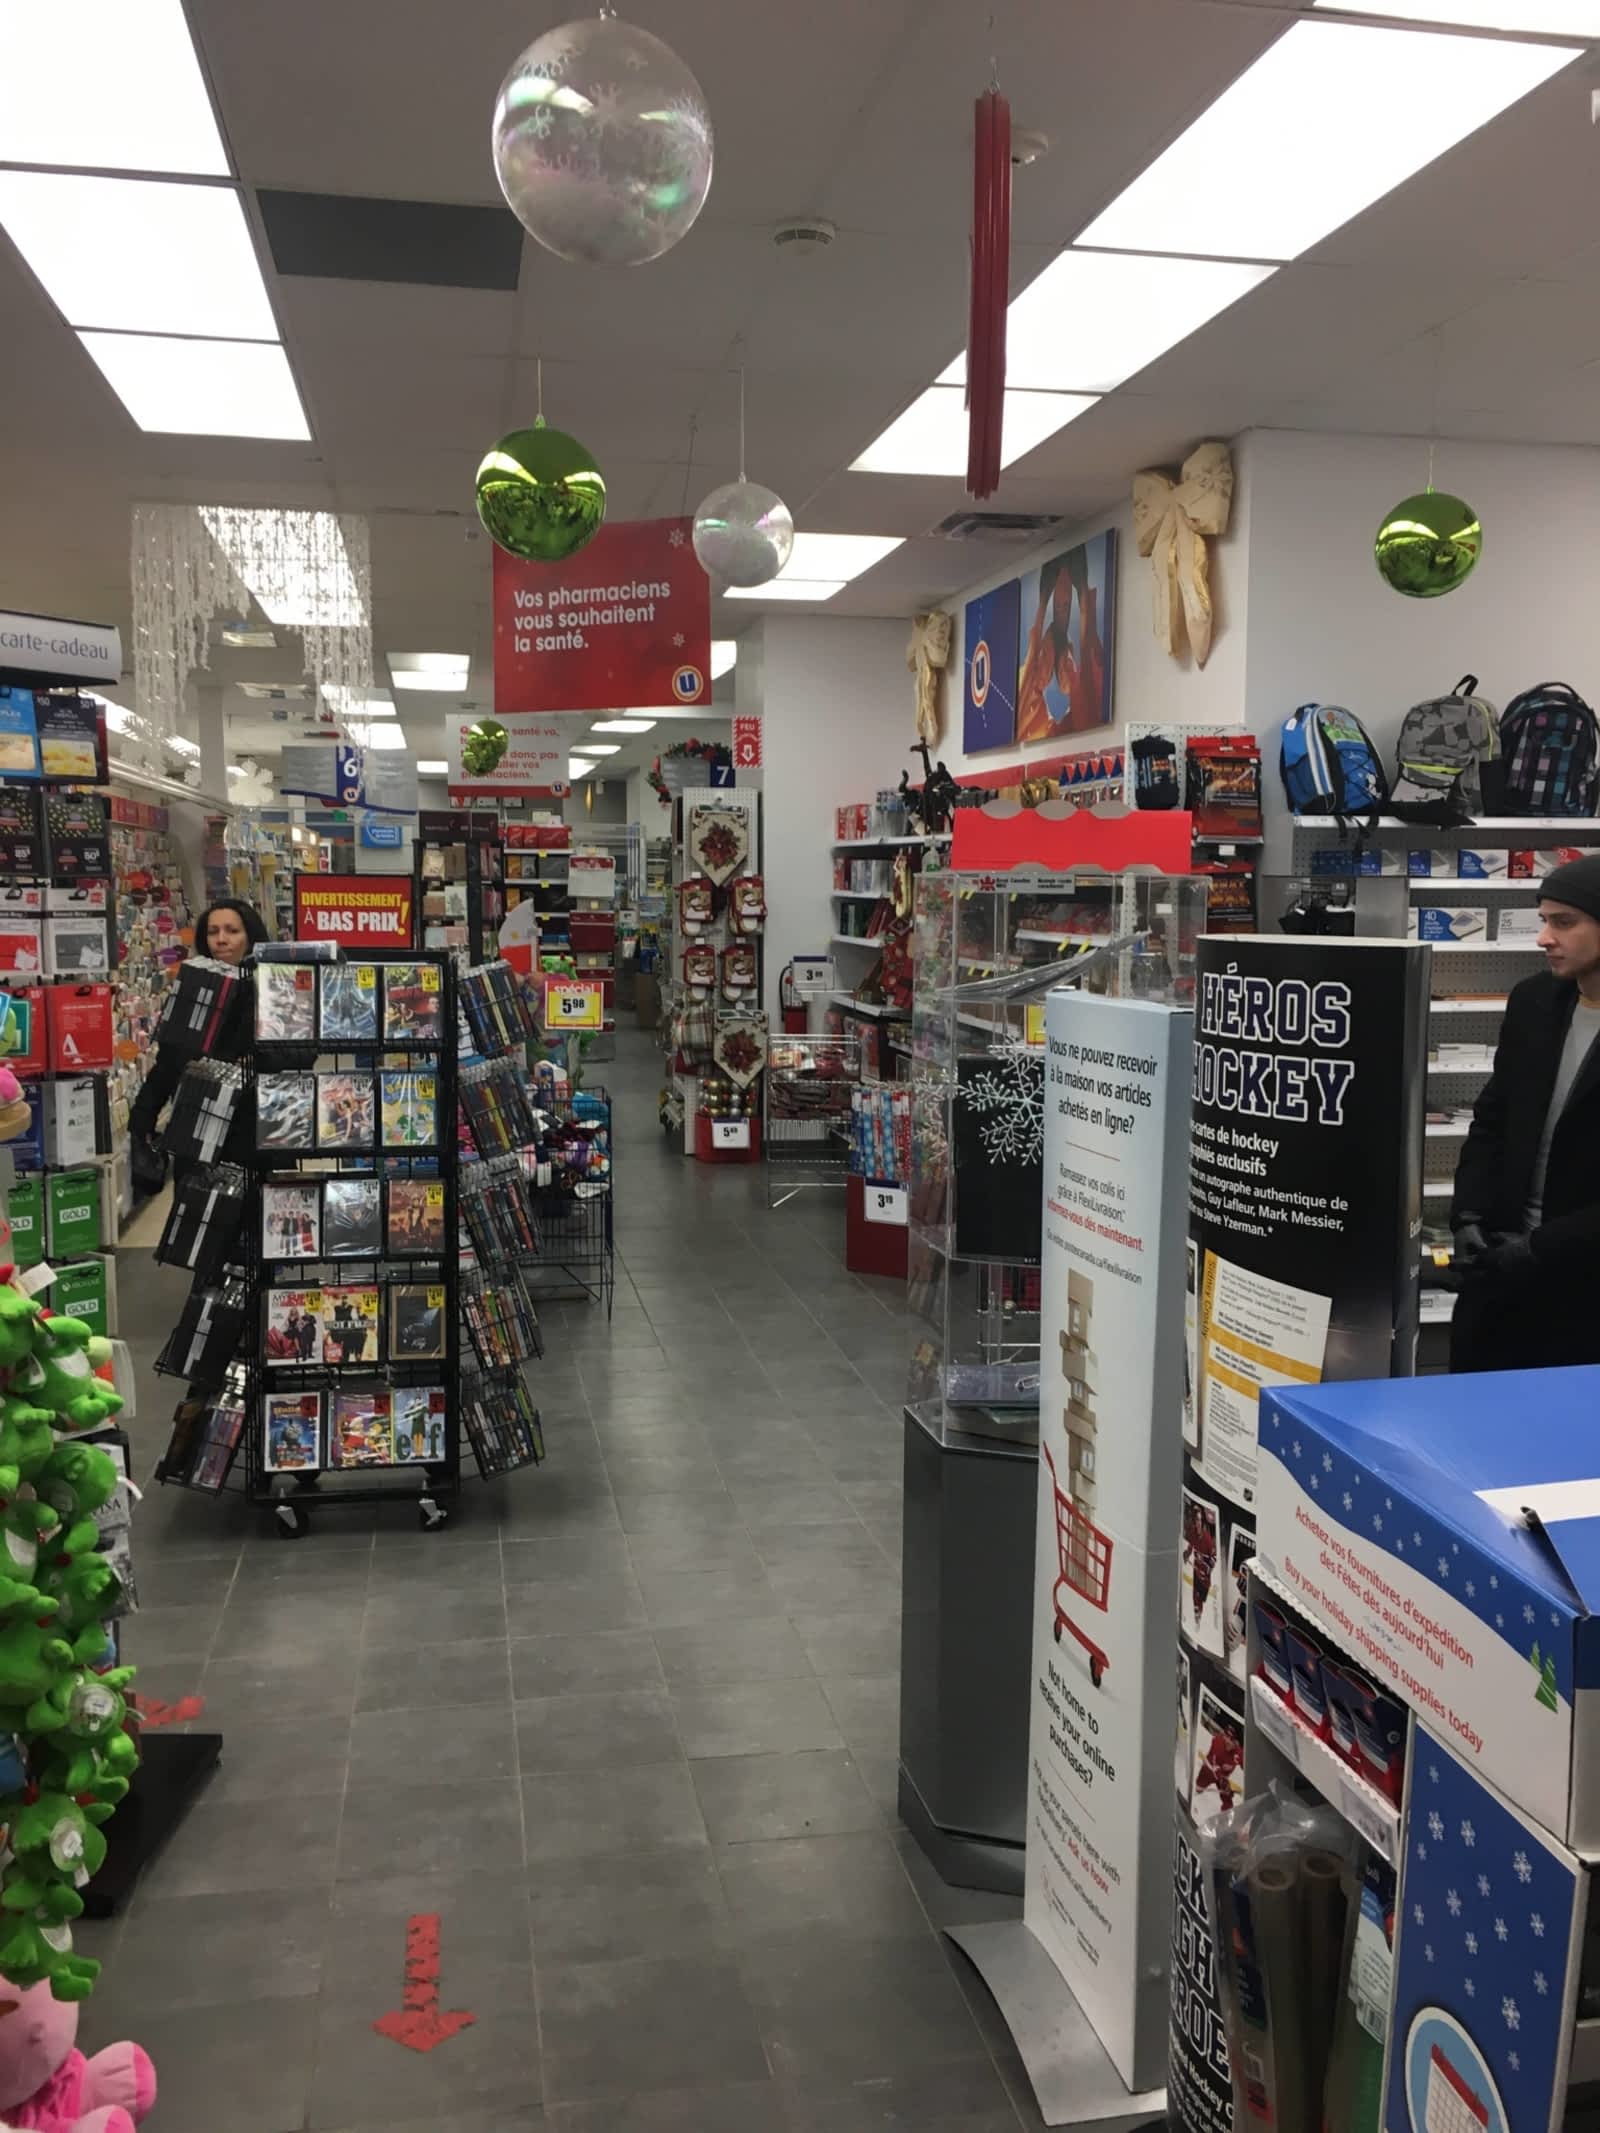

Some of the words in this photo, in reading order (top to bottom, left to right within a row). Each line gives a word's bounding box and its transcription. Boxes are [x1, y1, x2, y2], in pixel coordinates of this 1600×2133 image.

[513, 590, 543, 608] Vos
[549, 580, 671, 609] pharmaciens
[514, 613, 553, 631] vous
[558, 603, 656, 628] souhaitent
[0, 631, 108, 660] carte-cadeau
[515, 635, 531, 652] la
[535, 628, 589, 652] santé.
[343, 758, 357, 777] 6
[717, 766, 731, 785] 7
[301, 892, 402, 907] DIVERTISSEMENT
[304, 907, 315, 925] À
[317, 910, 354, 932] BAS
[1201, 962, 1352, 1048] HÉROS
[1048, 1035, 1068, 1057] Vous
[1068, 1043, 1079, 1060] ne
[1080, 1046, 1115, 1068] pouvez
[1116, 1054, 1158, 1076] recevoir
[1050, 1063, 1055, 1082] à
[1056, 1064, 1063, 1084] la
[1064, 1070, 1095, 1093] maison
[1096, 1079, 1113, 1099] vos
[1114, 1082, 1152, 1108] articles
[1058, 1096, 1089, 1122] achetés
[1090, 1108, 1103, 1126] en
[1104, 1107, 1135, 1135] ligne?
[1217, 1125, 1230, 1145] de
[1231, 1128, 1279, 1158] hockey
[1216, 1152, 1267, 1176] exclusifs
[1206, 1173, 1251, 1196] autographe
[1253, 1185, 1327, 1209] authentique
[1330, 1196, 1349, 1211] de
[61, 1207, 90, 1221] GOLD
[1203, 1207, 1222, 1225] Steve
[1207, 1191, 1222, 1210] Guy
[1223, 1195, 1257, 1217] Lafleur,
[1258, 1204, 1289, 1223] Mark
[1291, 1210, 1345, 1232] Messier,
[1096, 1223, 1145, 1252] maintenant.
[67, 1301, 97, 1316] GOLD
[1295, 1505, 1329, 1546] Achetez
[1330, 1538, 1347, 1560] vos
[1347, 1547, 1401, 1608] fournitures
[1403, 1599, 1474, 1669] d'expédition
[1319, 1550, 1336, 1575] des
[1337, 1565, 1362, 1597] Fêtes
[1363, 1589, 1381, 1616] dès
[1382, 1608, 1445, 1670] aujourd'hui
[1284, 1556, 1301, 1585] Buy
[1301, 1575, 1322, 1602] your
[1321, 1592, 1355, 1636] holiday
[1355, 1626, 1400, 1679] shipping
[1401, 1667, 1447, 1719] supplies
[1449, 1708, 1484, 1755] today
[1048, 1659, 1061, 1691] Not
[1062, 1677, 1086, 1721] home
[1088, 1712, 1099, 1735] to
[1049, 1723, 1093, 1789] purchases?
[1062, 1712, 1081, 1745] your
[1082, 1739, 1115, 1782] online
